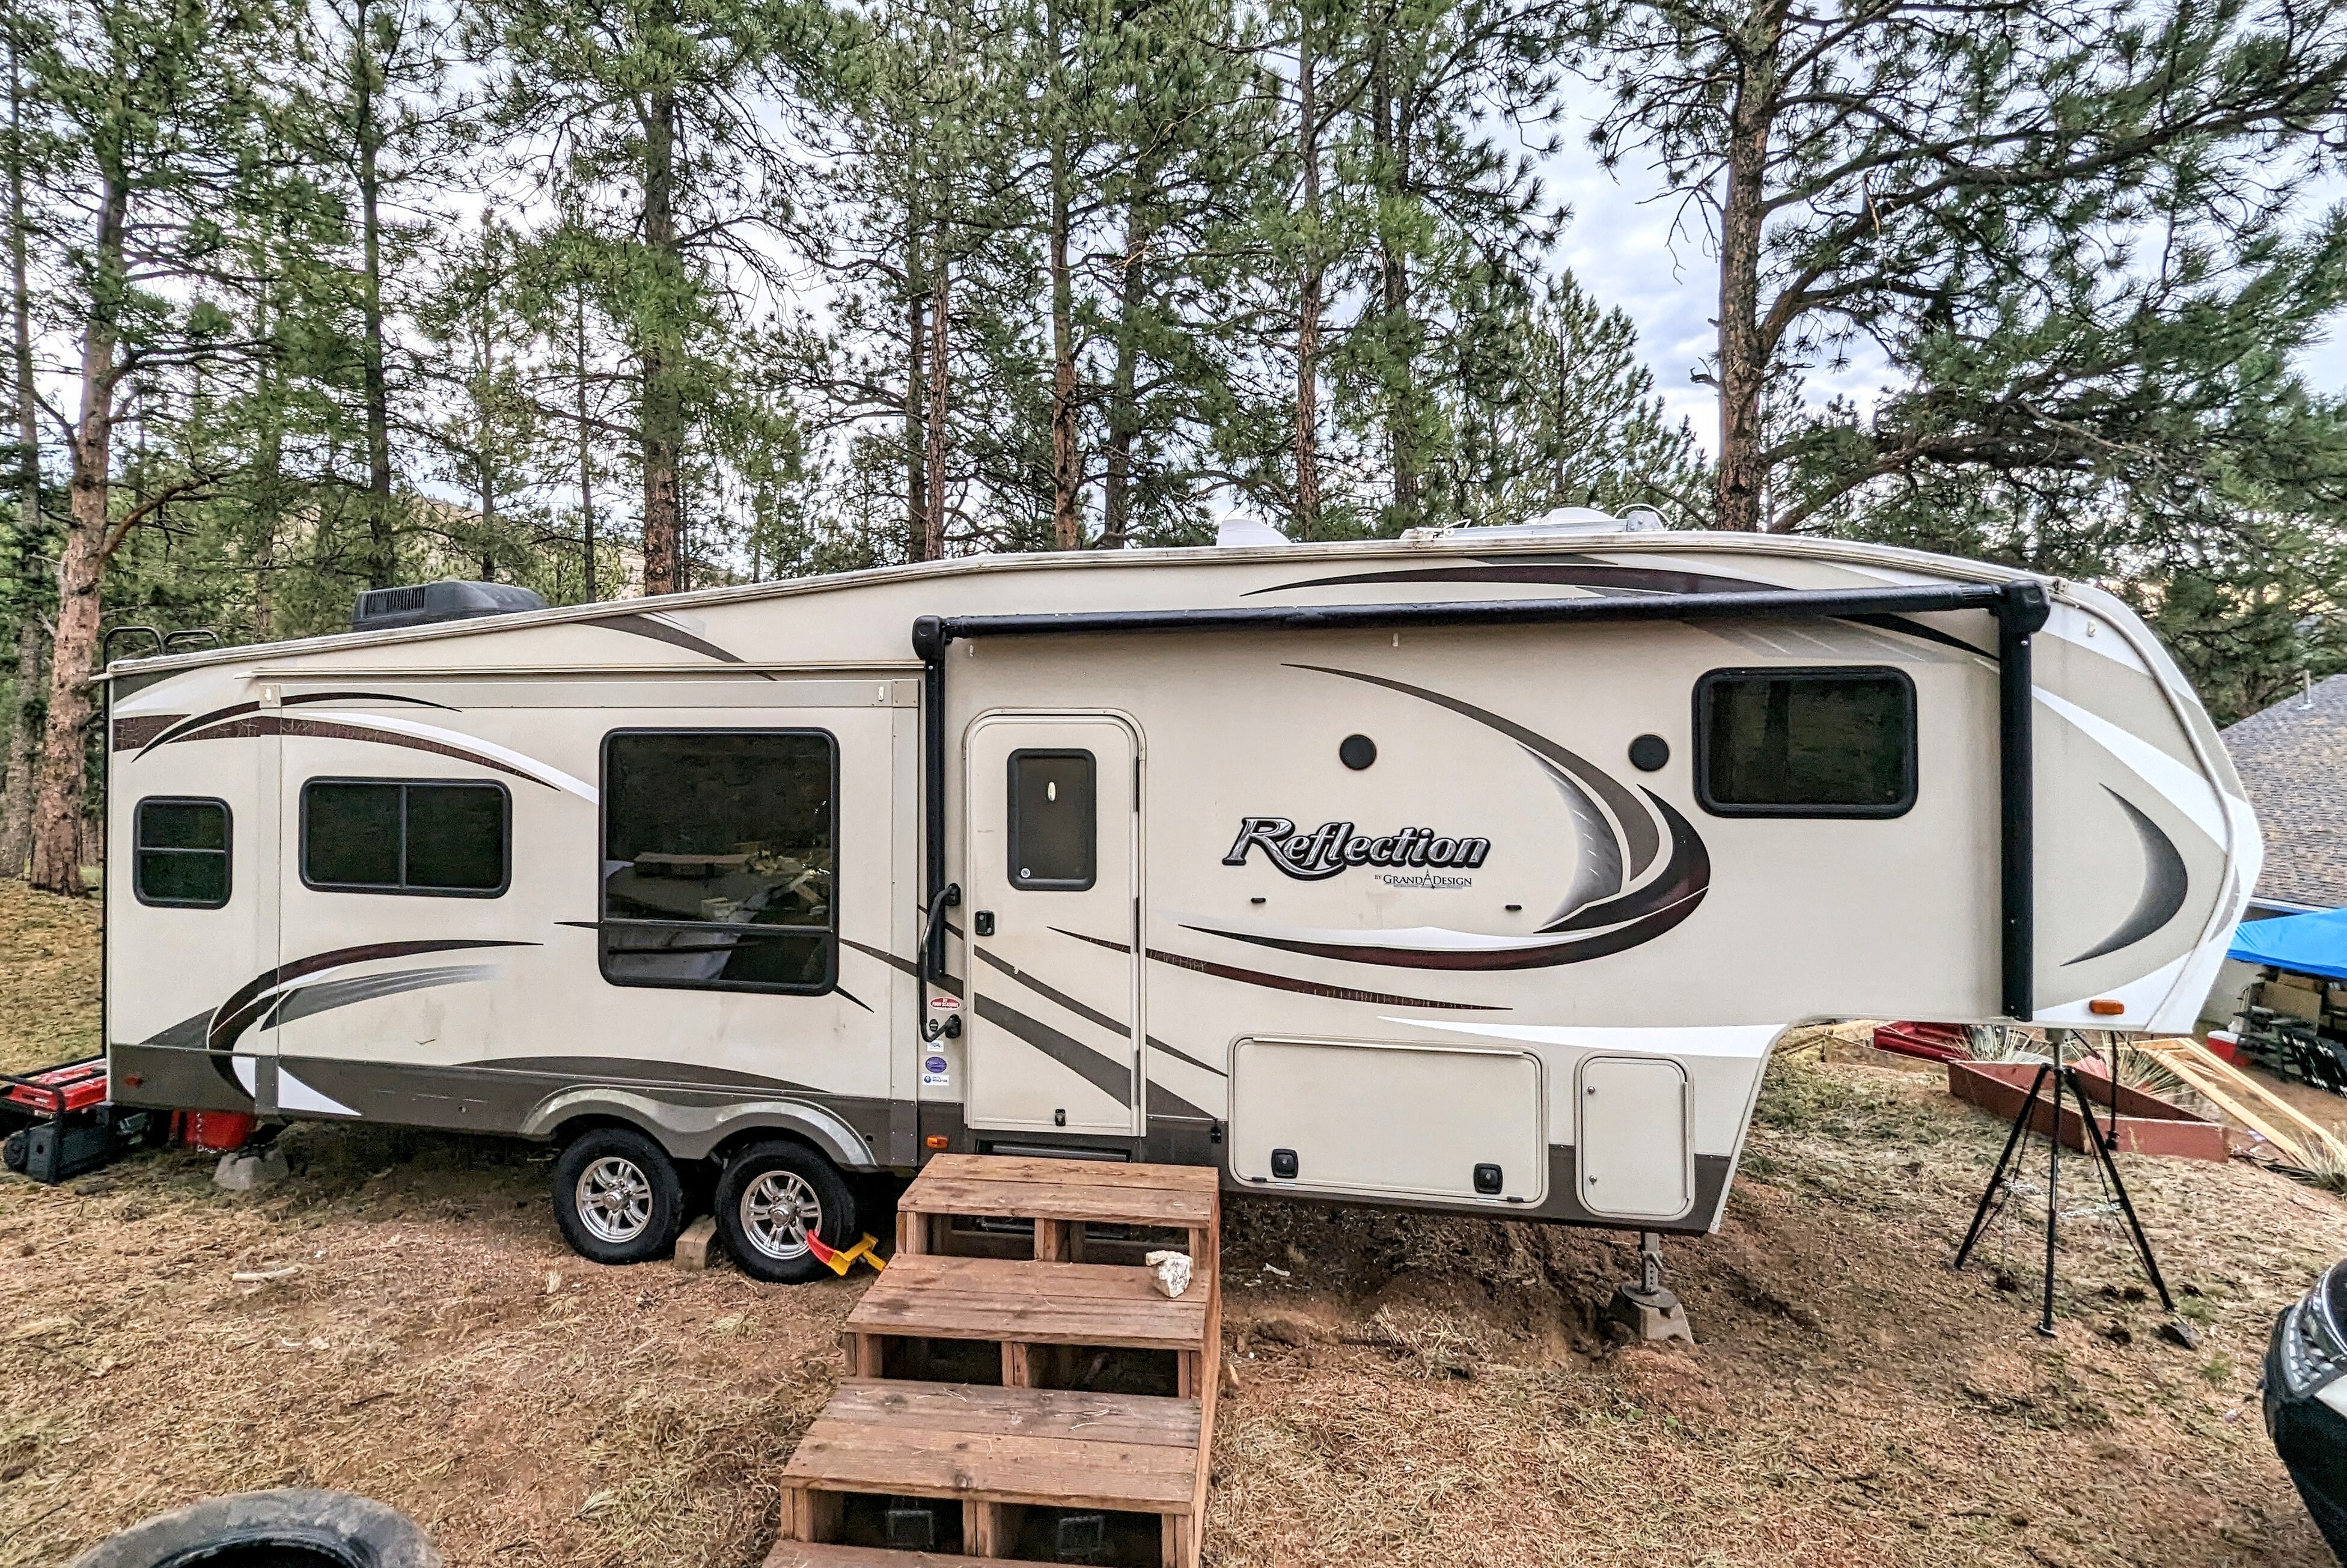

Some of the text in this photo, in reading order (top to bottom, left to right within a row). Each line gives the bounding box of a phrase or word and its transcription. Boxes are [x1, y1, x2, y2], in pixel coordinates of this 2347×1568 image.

[1222, 817, 1491, 880] Reflection
[1383, 874, 1423, 884] GRAND
[1433, 876, 1472, 885] DESIGN
